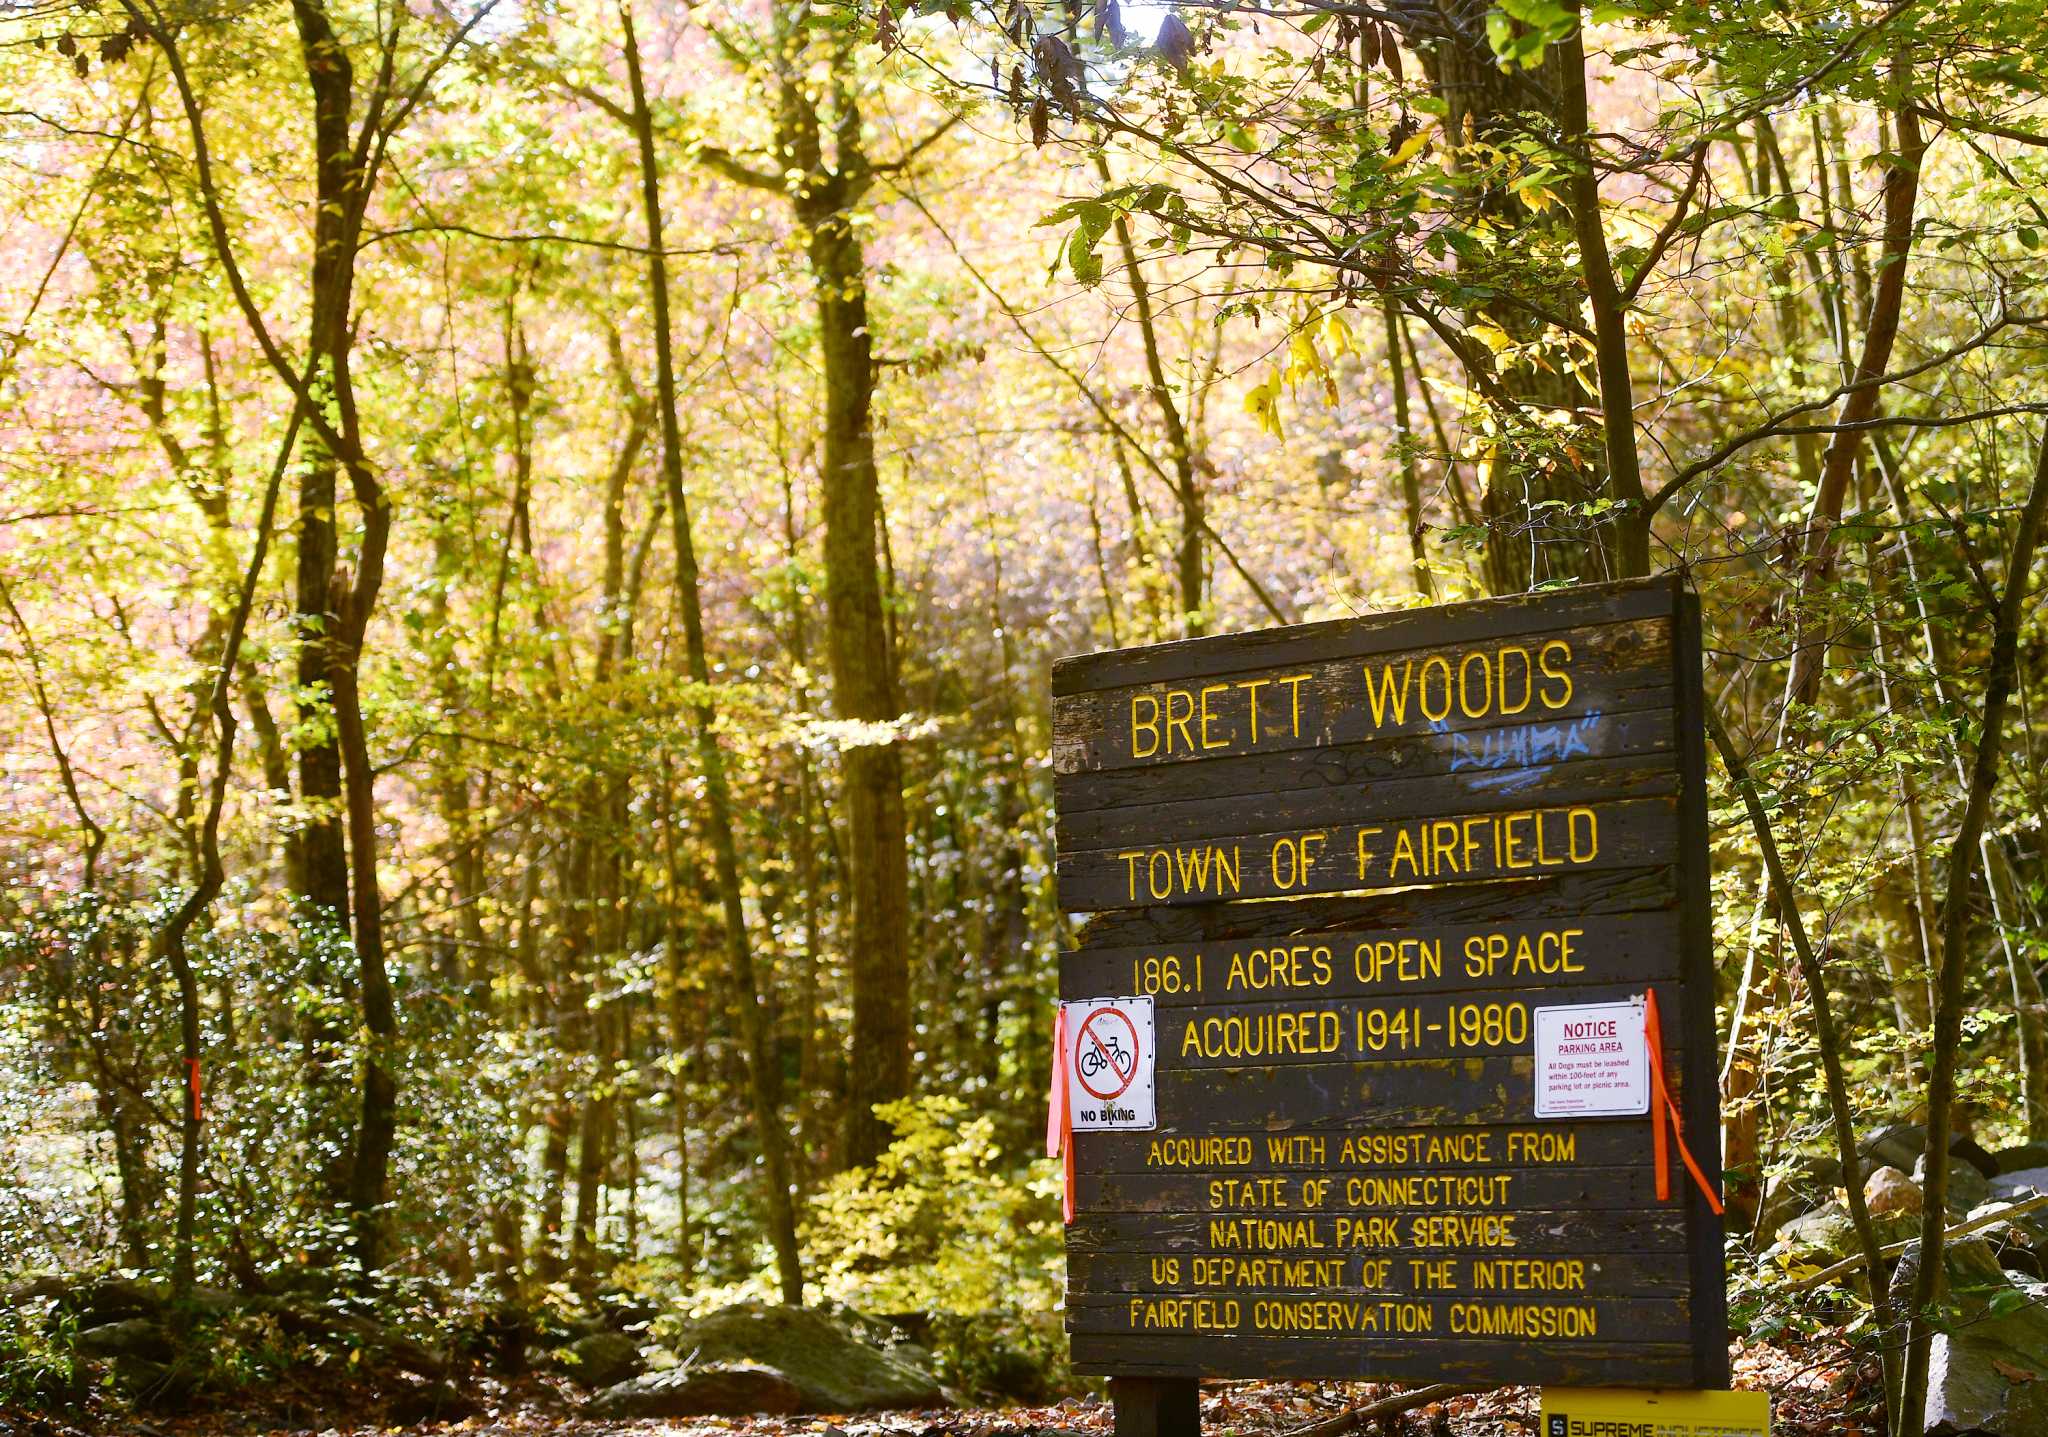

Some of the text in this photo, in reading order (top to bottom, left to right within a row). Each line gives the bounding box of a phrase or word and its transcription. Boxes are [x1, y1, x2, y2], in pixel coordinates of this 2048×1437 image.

[1131, 639, 1574, 758] BRETT WOODS
[1118, 807, 1599, 900] TOWN OF FAIRFIELD
[1134, 929, 1586, 995] 186.1 ACRES OPEN SPACE
[1181, 1002, 1528, 1057] ACQUIRED 1941-1980
[1563, 1020, 1617, 1038] NOTICE
[1558, 1041, 1623, 1054] PARKING AREA
[1548, 1062, 1557, 1070] All
[1558, 1061, 1574, 1071] Dogs
[1576, 1061, 1592, 1069] must
[1603, 1059, 1630, 1067] leashed
[1598, 1071, 1606, 1079] of
[1606, 1071, 1618, 1079] any
[1548, 1083, 1572, 1092] parking
[1573, 1082, 1582, 1090] lot
[1592, 1080, 1612, 1090] picnic
[1080, 1109, 1136, 1122] NO BIKING
[1146, 1131, 1576, 1168] ACQUIRED WITH ASSISTANCE FROM
[1209, 1175, 1513, 1208] STATE OF CONNECTICUT
[1209, 1214, 1517, 1249] NATIONAL PARK SERVICE
[1151, 1257, 1585, 1290] US DEPARTMENT OF THE INTERIOR
[1130, 1298, 1597, 1338] FAIRFIELD CONSERVATION COMMISSION
[1571, 1421, 1654, 1437] SUPREME
